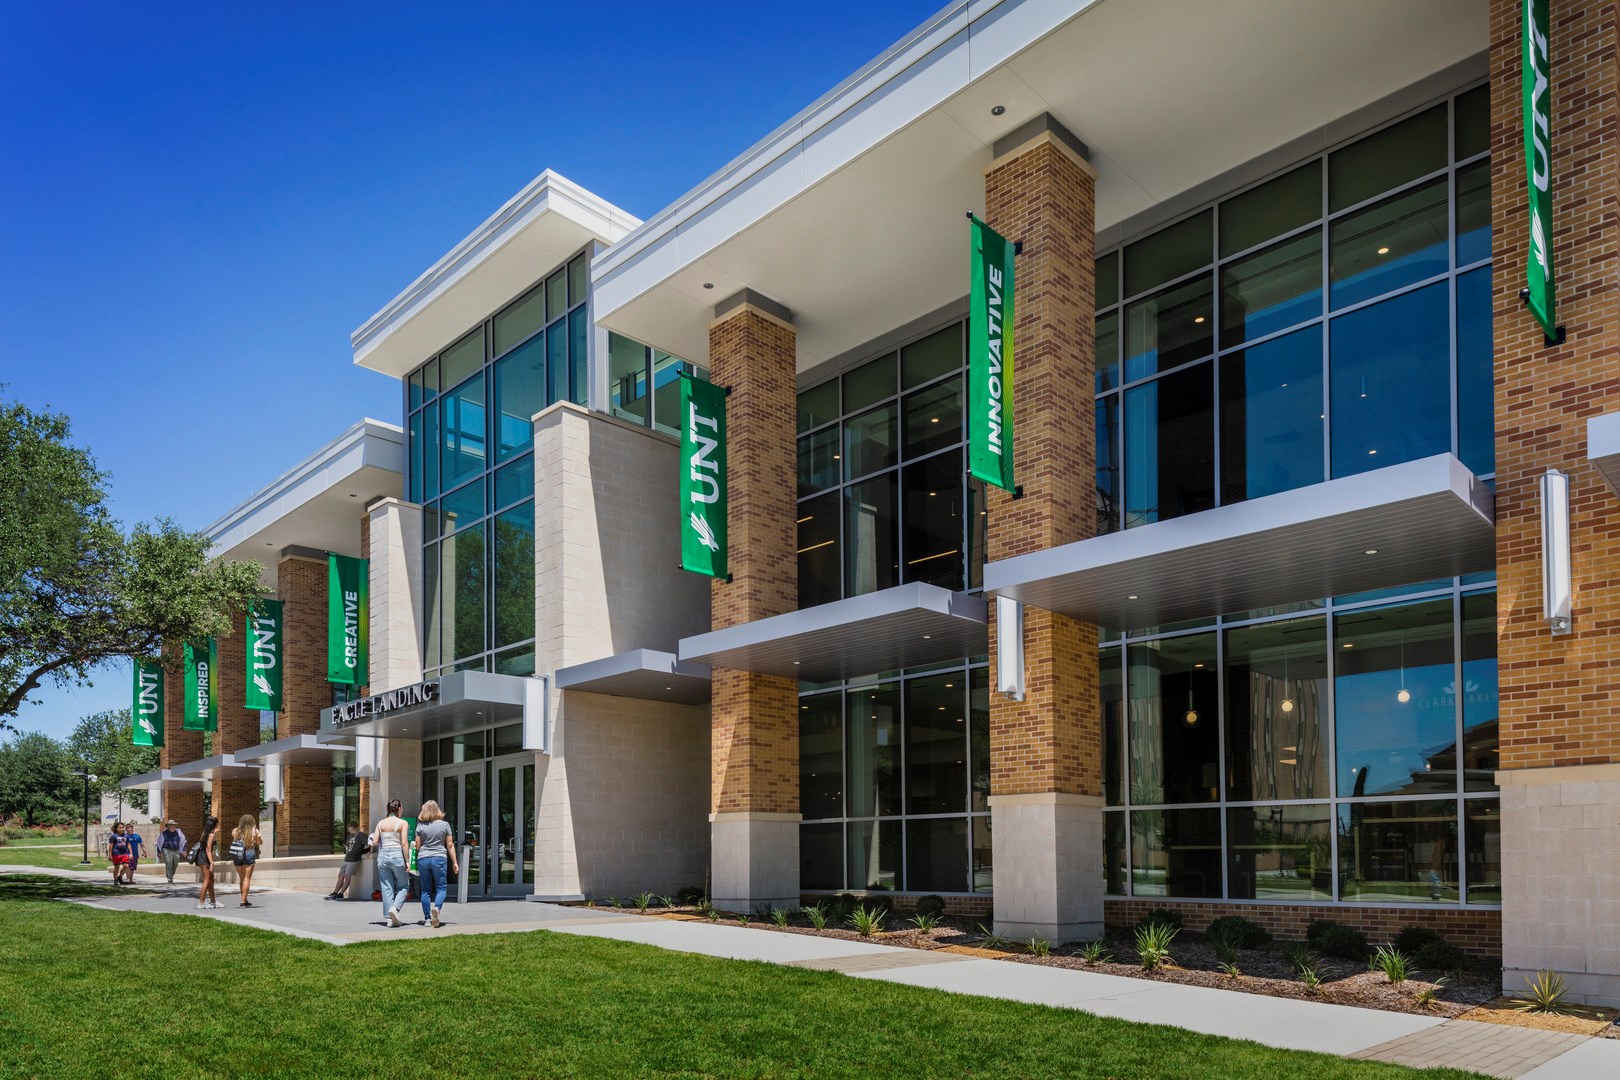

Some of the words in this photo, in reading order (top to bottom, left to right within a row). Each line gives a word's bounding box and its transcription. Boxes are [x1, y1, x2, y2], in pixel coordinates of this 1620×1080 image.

[1528, 0, 1548, 192] UNT
[988, 264, 1002, 455] INNOVATIVE
[689, 401, 719, 504] UNT
[253, 611, 277, 670] UNT
[344, 591, 358, 668] CREATIVE
[139, 668, 158, 715] UNT
[197, 661, 209, 718] INSPIRED
[331, 699, 367, 725] EAGLE
[372, 681, 436, 714] LANDING
[1418, 695, 1455, 709] CLARK
